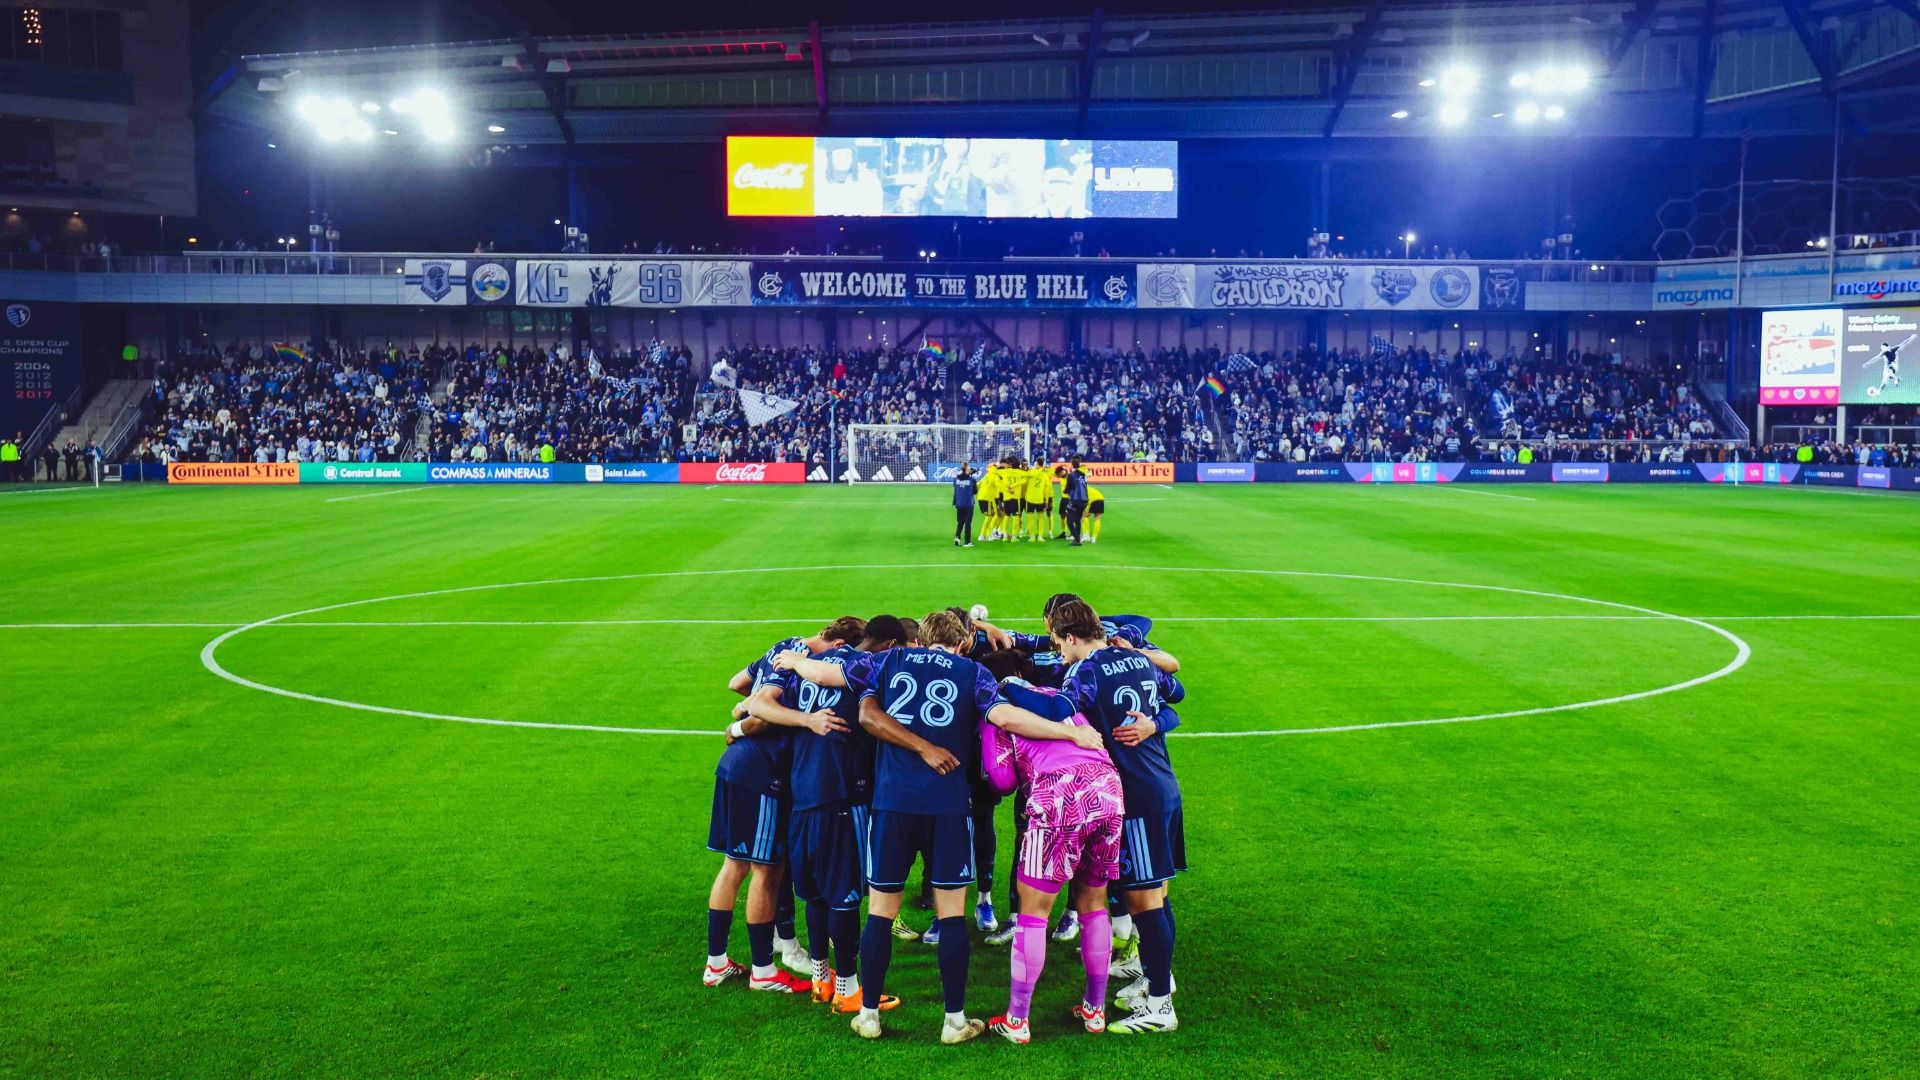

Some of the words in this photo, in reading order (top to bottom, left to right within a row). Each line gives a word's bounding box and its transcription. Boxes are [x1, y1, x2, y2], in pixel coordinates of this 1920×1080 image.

[1233, 266, 1288, 277] KANSAS
[1293, 267, 1328, 280] CITY
[527, 263, 568, 303] KC
[639, 263, 682, 304] 96
[800, 272, 906, 297] WELCOME
[916, 278, 934, 295] TO
[940, 278, 966, 296] THE
[975, 274, 1027, 299] BLUE
[1036, 275, 1088, 299] HELL
[1836, 279, 1920, 296] mazuma
[1211, 277, 1345, 307] CAULDRON
[1657, 287, 1734, 304] mazuma
[16, 339, 45, 347] OPEN
[47, 340, 69, 348] CUP
[0, 347, 64, 355] CHAMPIONS
[15, 362, 51, 370] 2004
[15, 371, 52, 380] 2012
[16, 390, 53, 399] 2017
[172, 464, 249, 480] Continental
[263, 464, 295, 478] Tire
[340, 467, 374, 478] Central
[376, 467, 402, 478] Bank
[431, 467, 486, 479] COMPASS
[494, 467, 550, 479] MINERALS
[605, 469, 623, 477] Saint
[1141, 464, 1170, 477] Tire
[1398, 468, 1410, 477] VS
[1469, 468, 1505, 476] COLUMBUS
[1506, 468, 1526, 476] CREW
[905, 652, 953, 669] MEYER
[886, 671, 959, 727] 28
